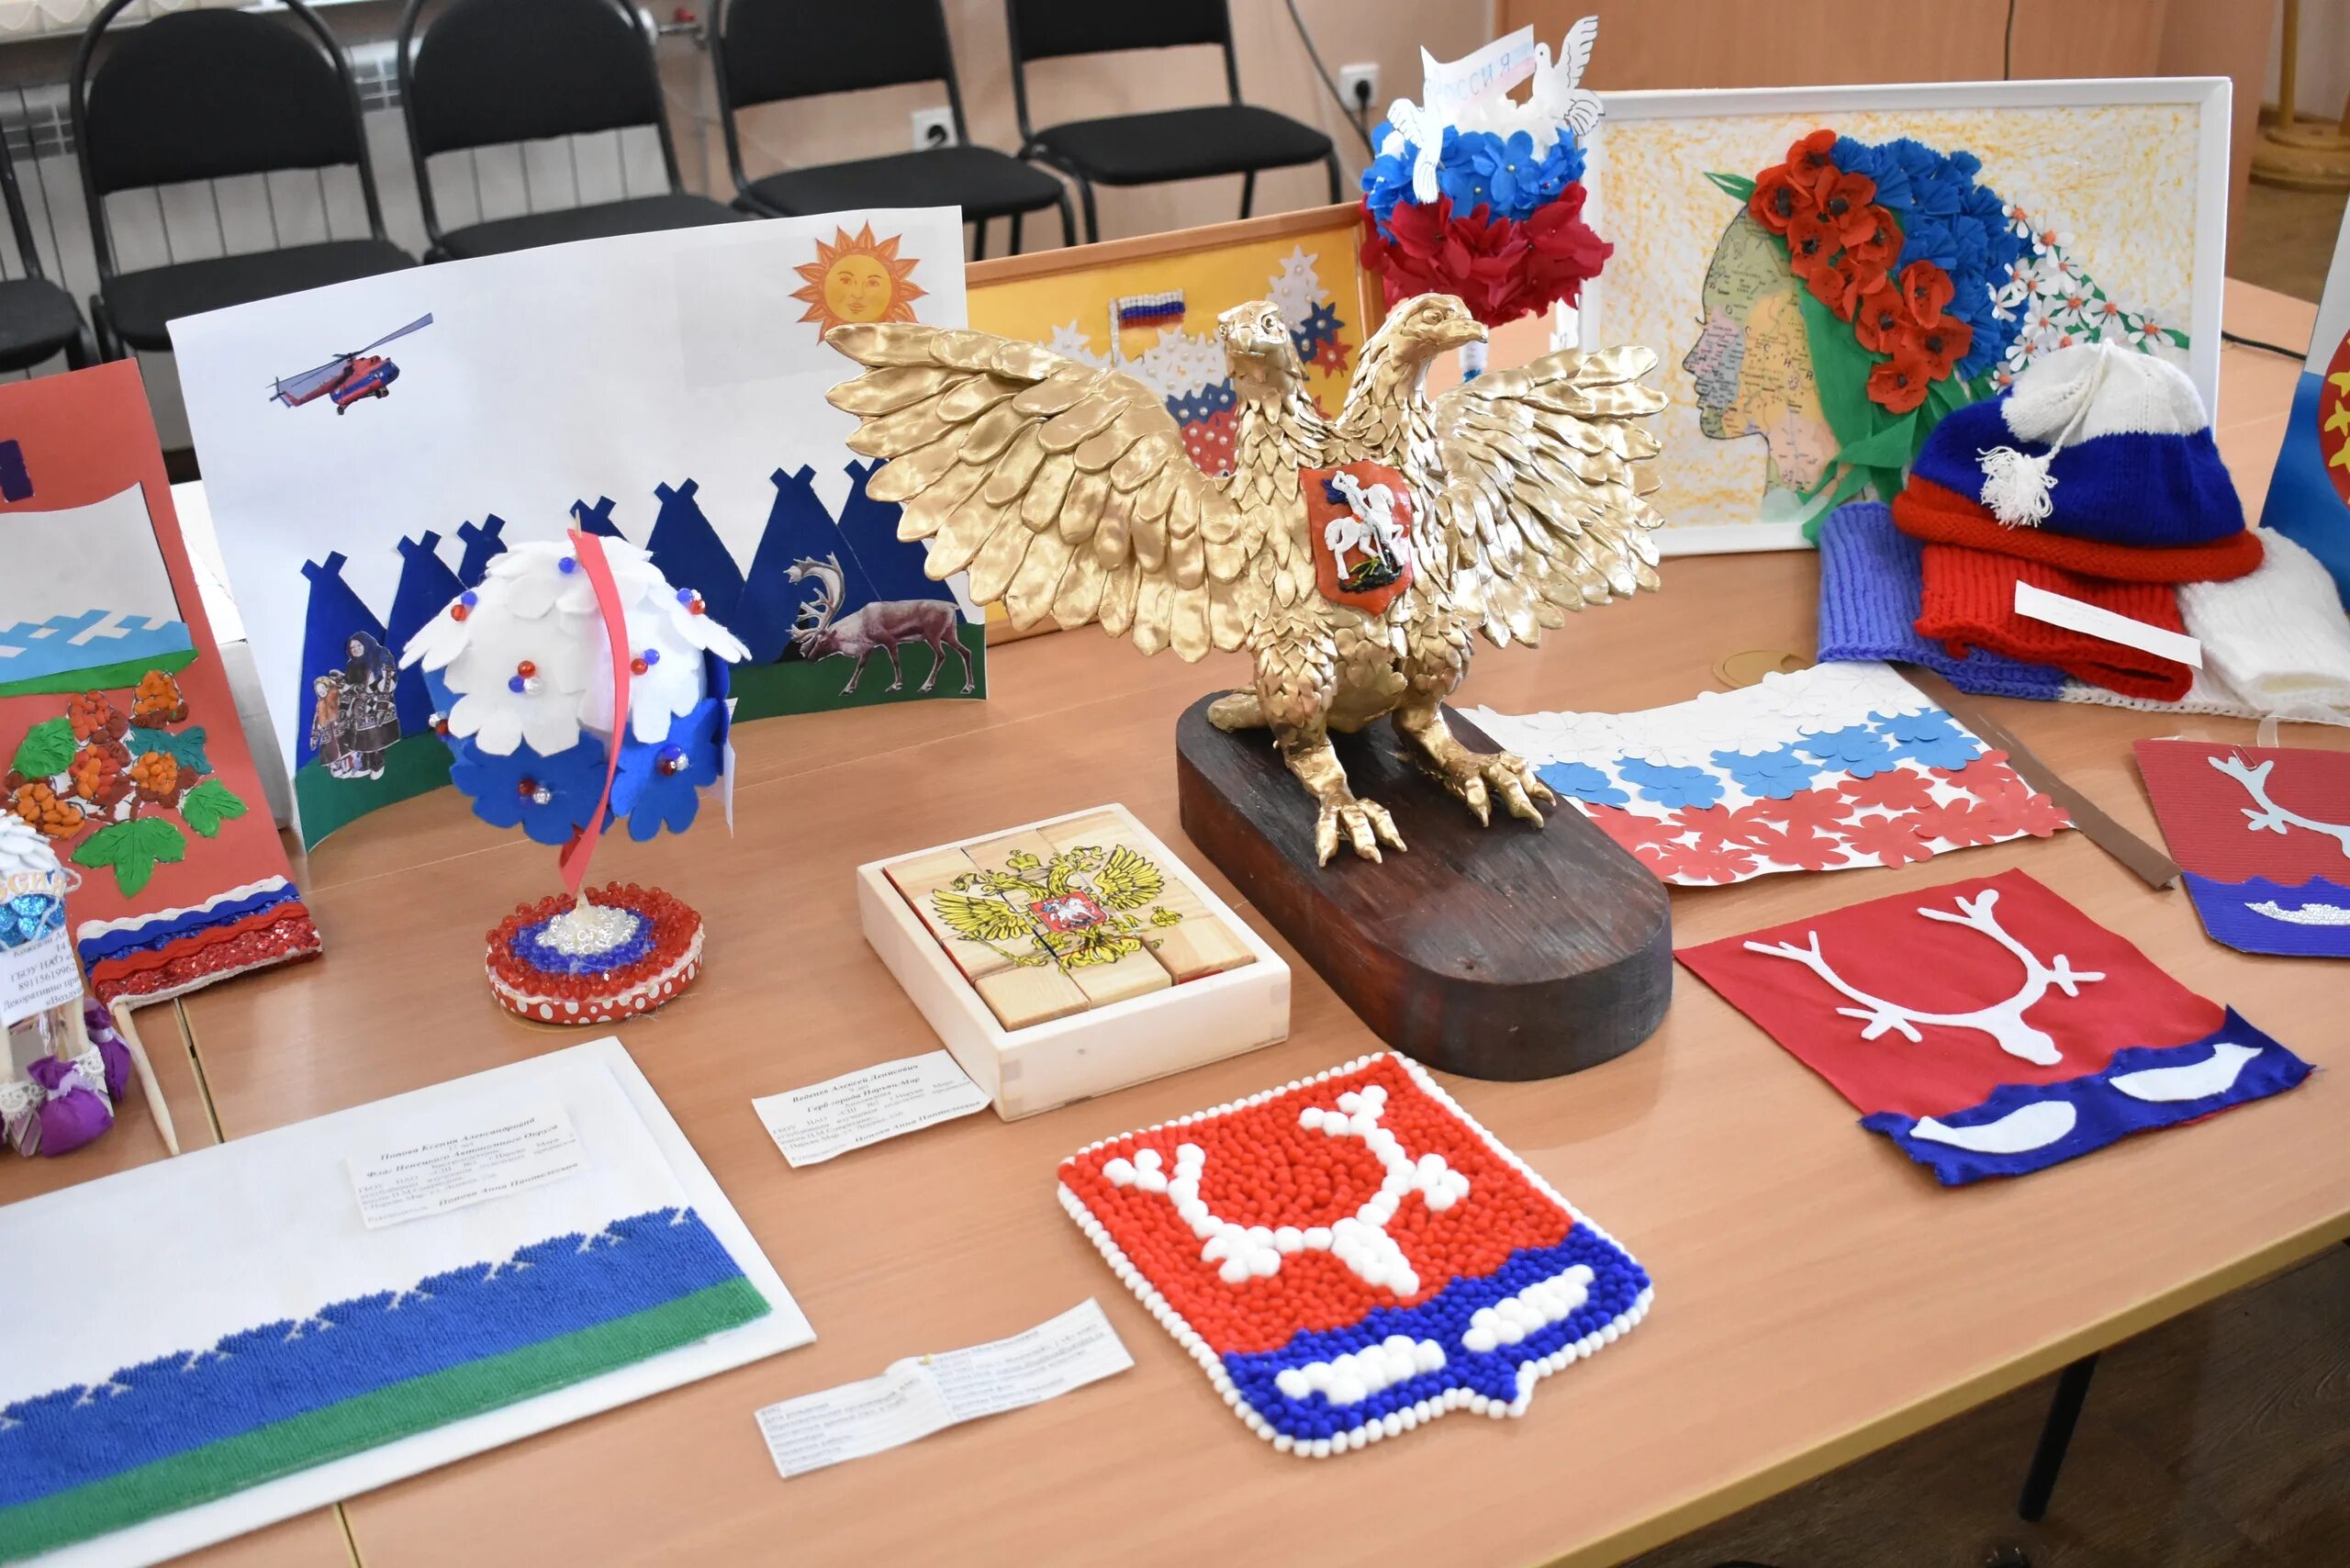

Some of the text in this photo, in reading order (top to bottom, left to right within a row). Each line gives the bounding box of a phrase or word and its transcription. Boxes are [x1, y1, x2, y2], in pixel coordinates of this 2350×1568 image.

[11, 965, 37, 982] ГБОУ
[39, 954, 63, 970] НАО
[4, 983, 62, 1012] Декоративно
